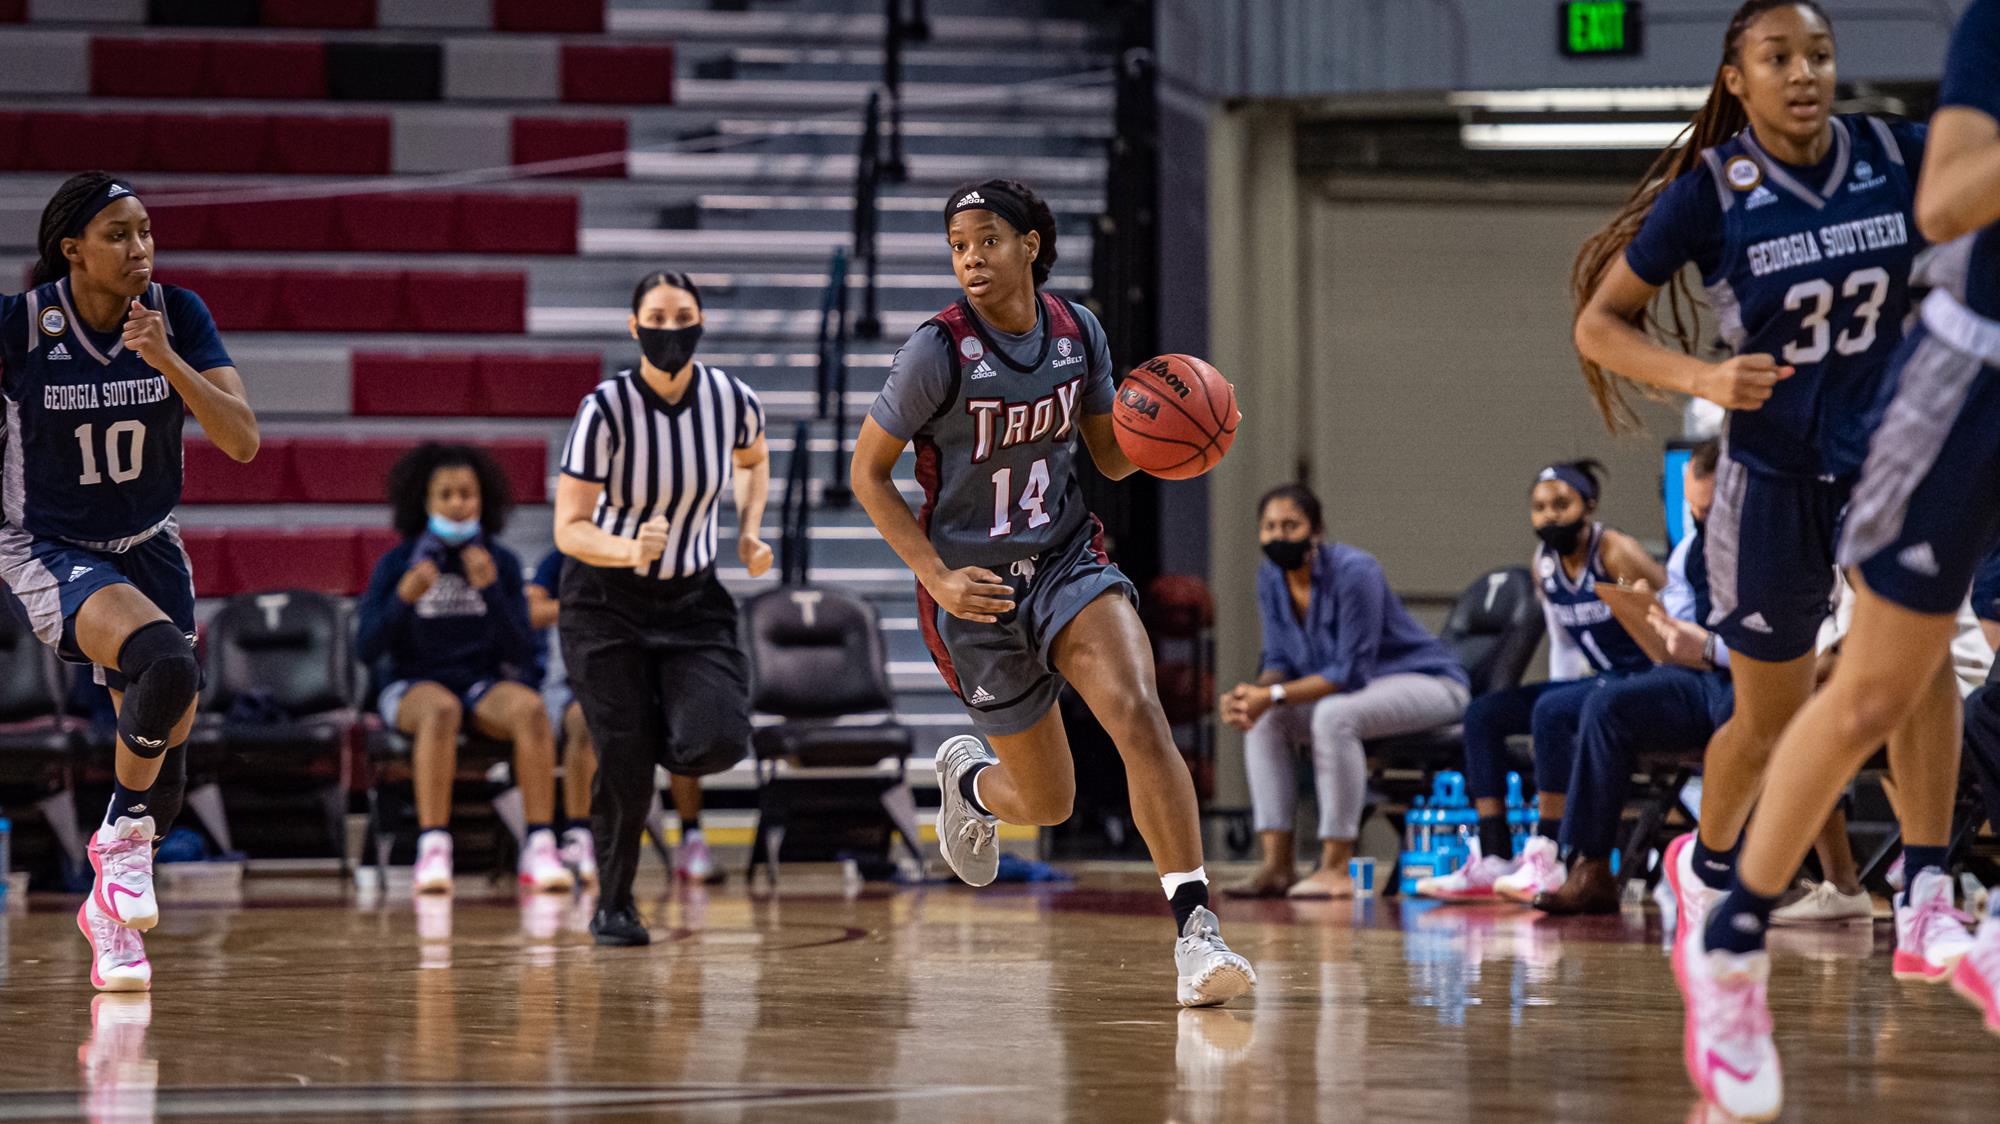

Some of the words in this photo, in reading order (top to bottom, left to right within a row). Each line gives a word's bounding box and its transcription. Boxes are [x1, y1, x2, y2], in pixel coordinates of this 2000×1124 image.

[1568, 2, 1623, 52] EXIT
[956, 198, 985, 208] adidas
[1747, 231, 1822, 277] GEORGIA
[1819, 212, 1908, 259] SOUTHERN
[1782, 266, 1890, 364] 33
[44, 384, 100, 411] GEORGIA
[971, 371, 997, 380] adidas
[967, 376, 1083, 463] TROY
[74, 420, 146, 485] 10
[989, 458, 1051, 538] 14
[256, 593, 290, 631] T
[790, 591, 823, 627] T
[971, 694, 996, 705] adidas
